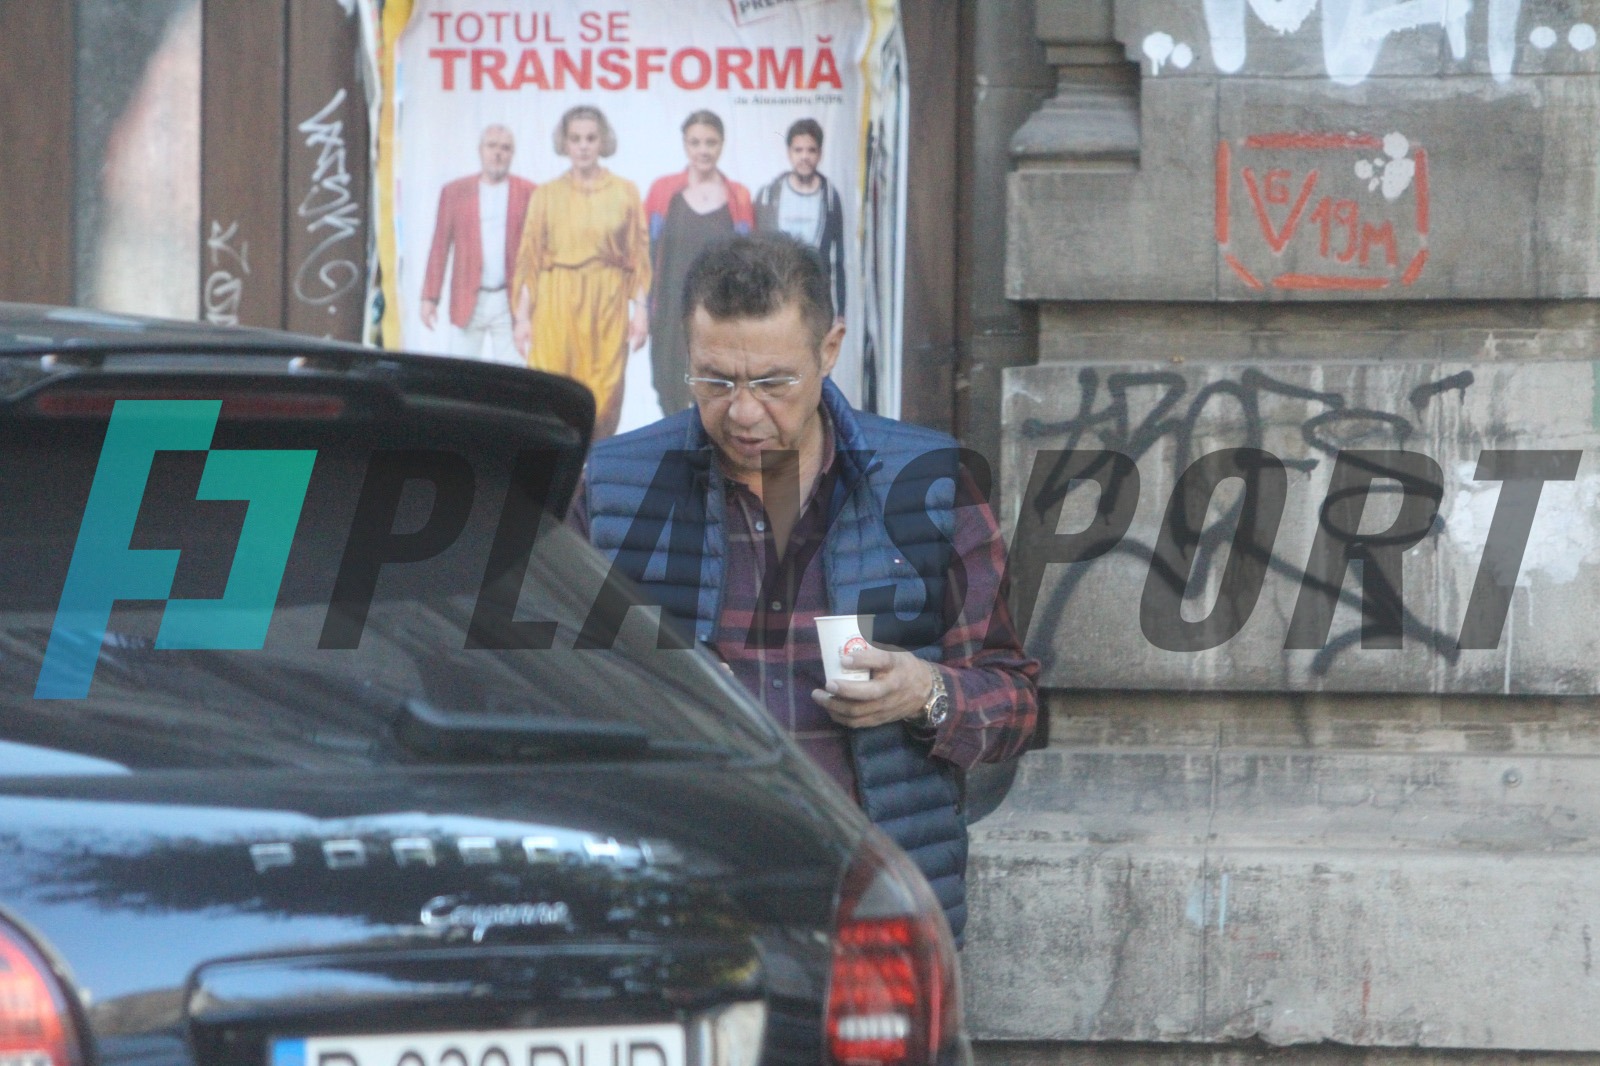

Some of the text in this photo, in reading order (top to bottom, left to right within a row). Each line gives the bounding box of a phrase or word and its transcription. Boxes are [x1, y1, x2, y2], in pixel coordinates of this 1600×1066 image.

[429, 10, 630, 43] TOTUL SE
[429, 34, 843, 91] TRANSFORMĂ
